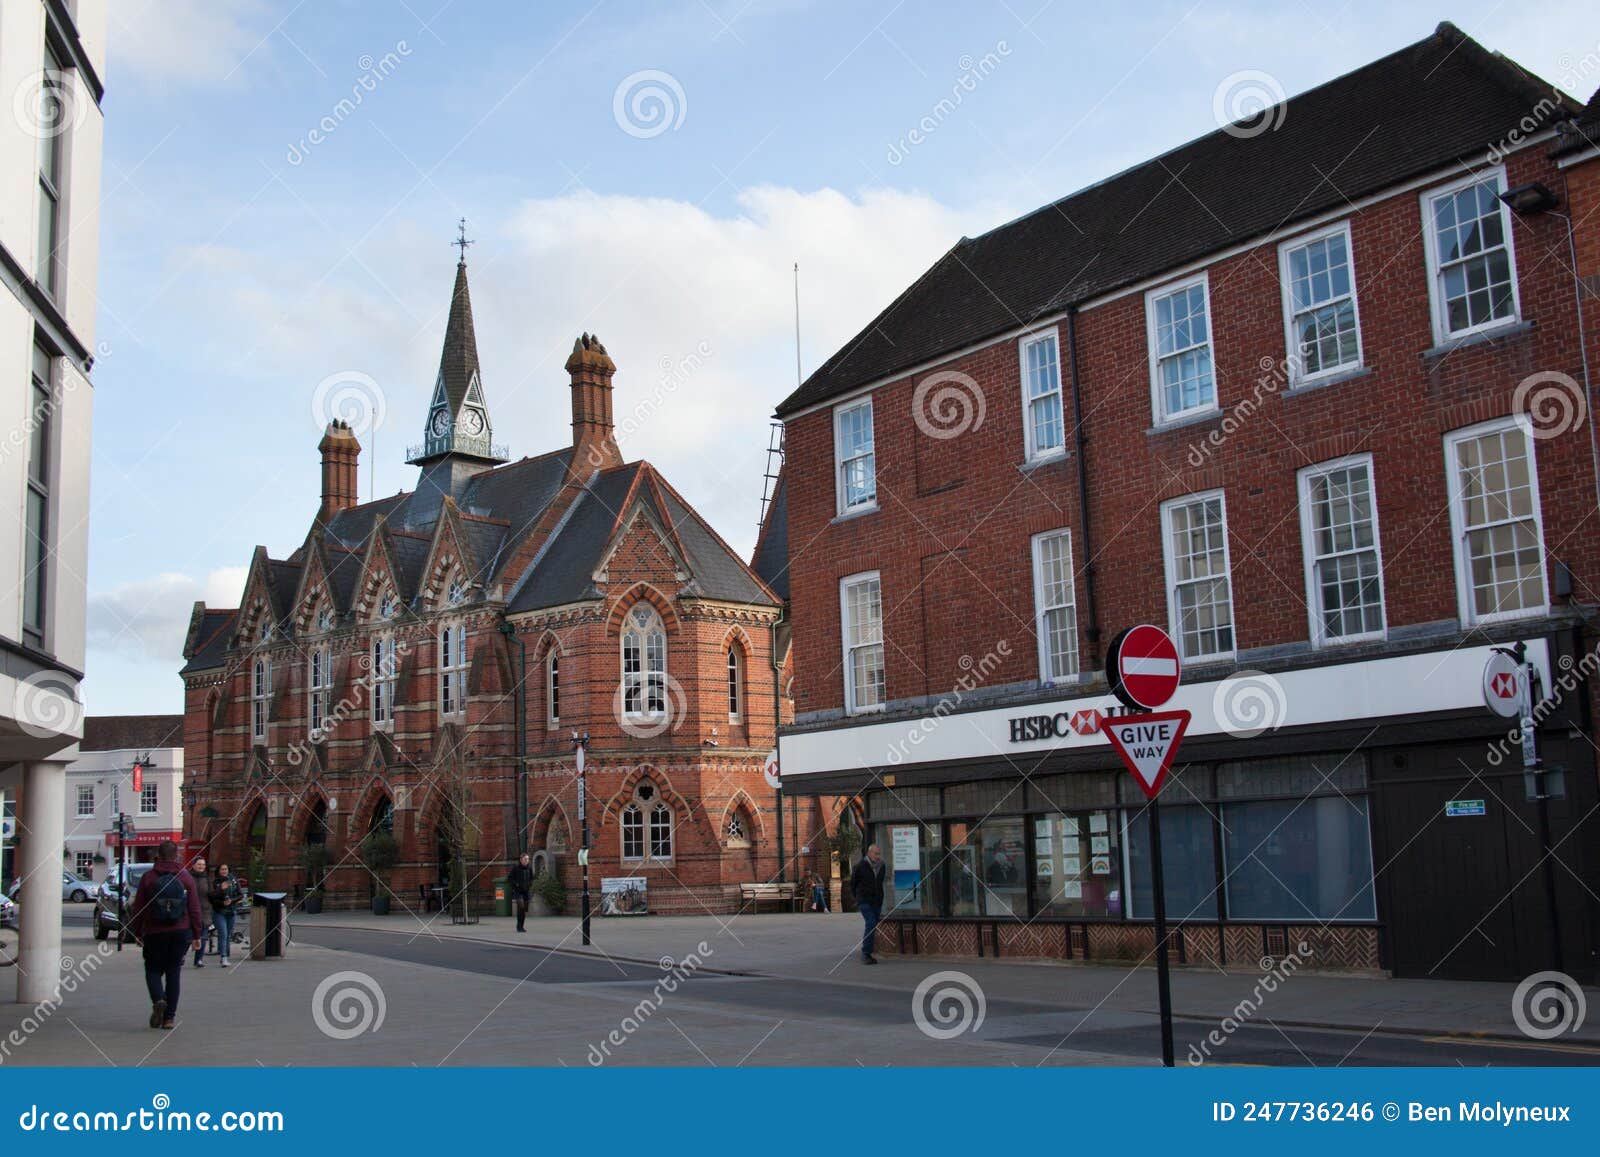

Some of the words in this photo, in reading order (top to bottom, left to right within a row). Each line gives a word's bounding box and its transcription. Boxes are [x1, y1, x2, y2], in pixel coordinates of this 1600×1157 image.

[1008, 712, 1070, 743] HSBC
[1121, 724, 1171, 744] GIVE
[1133, 746, 1165, 759] WAY
